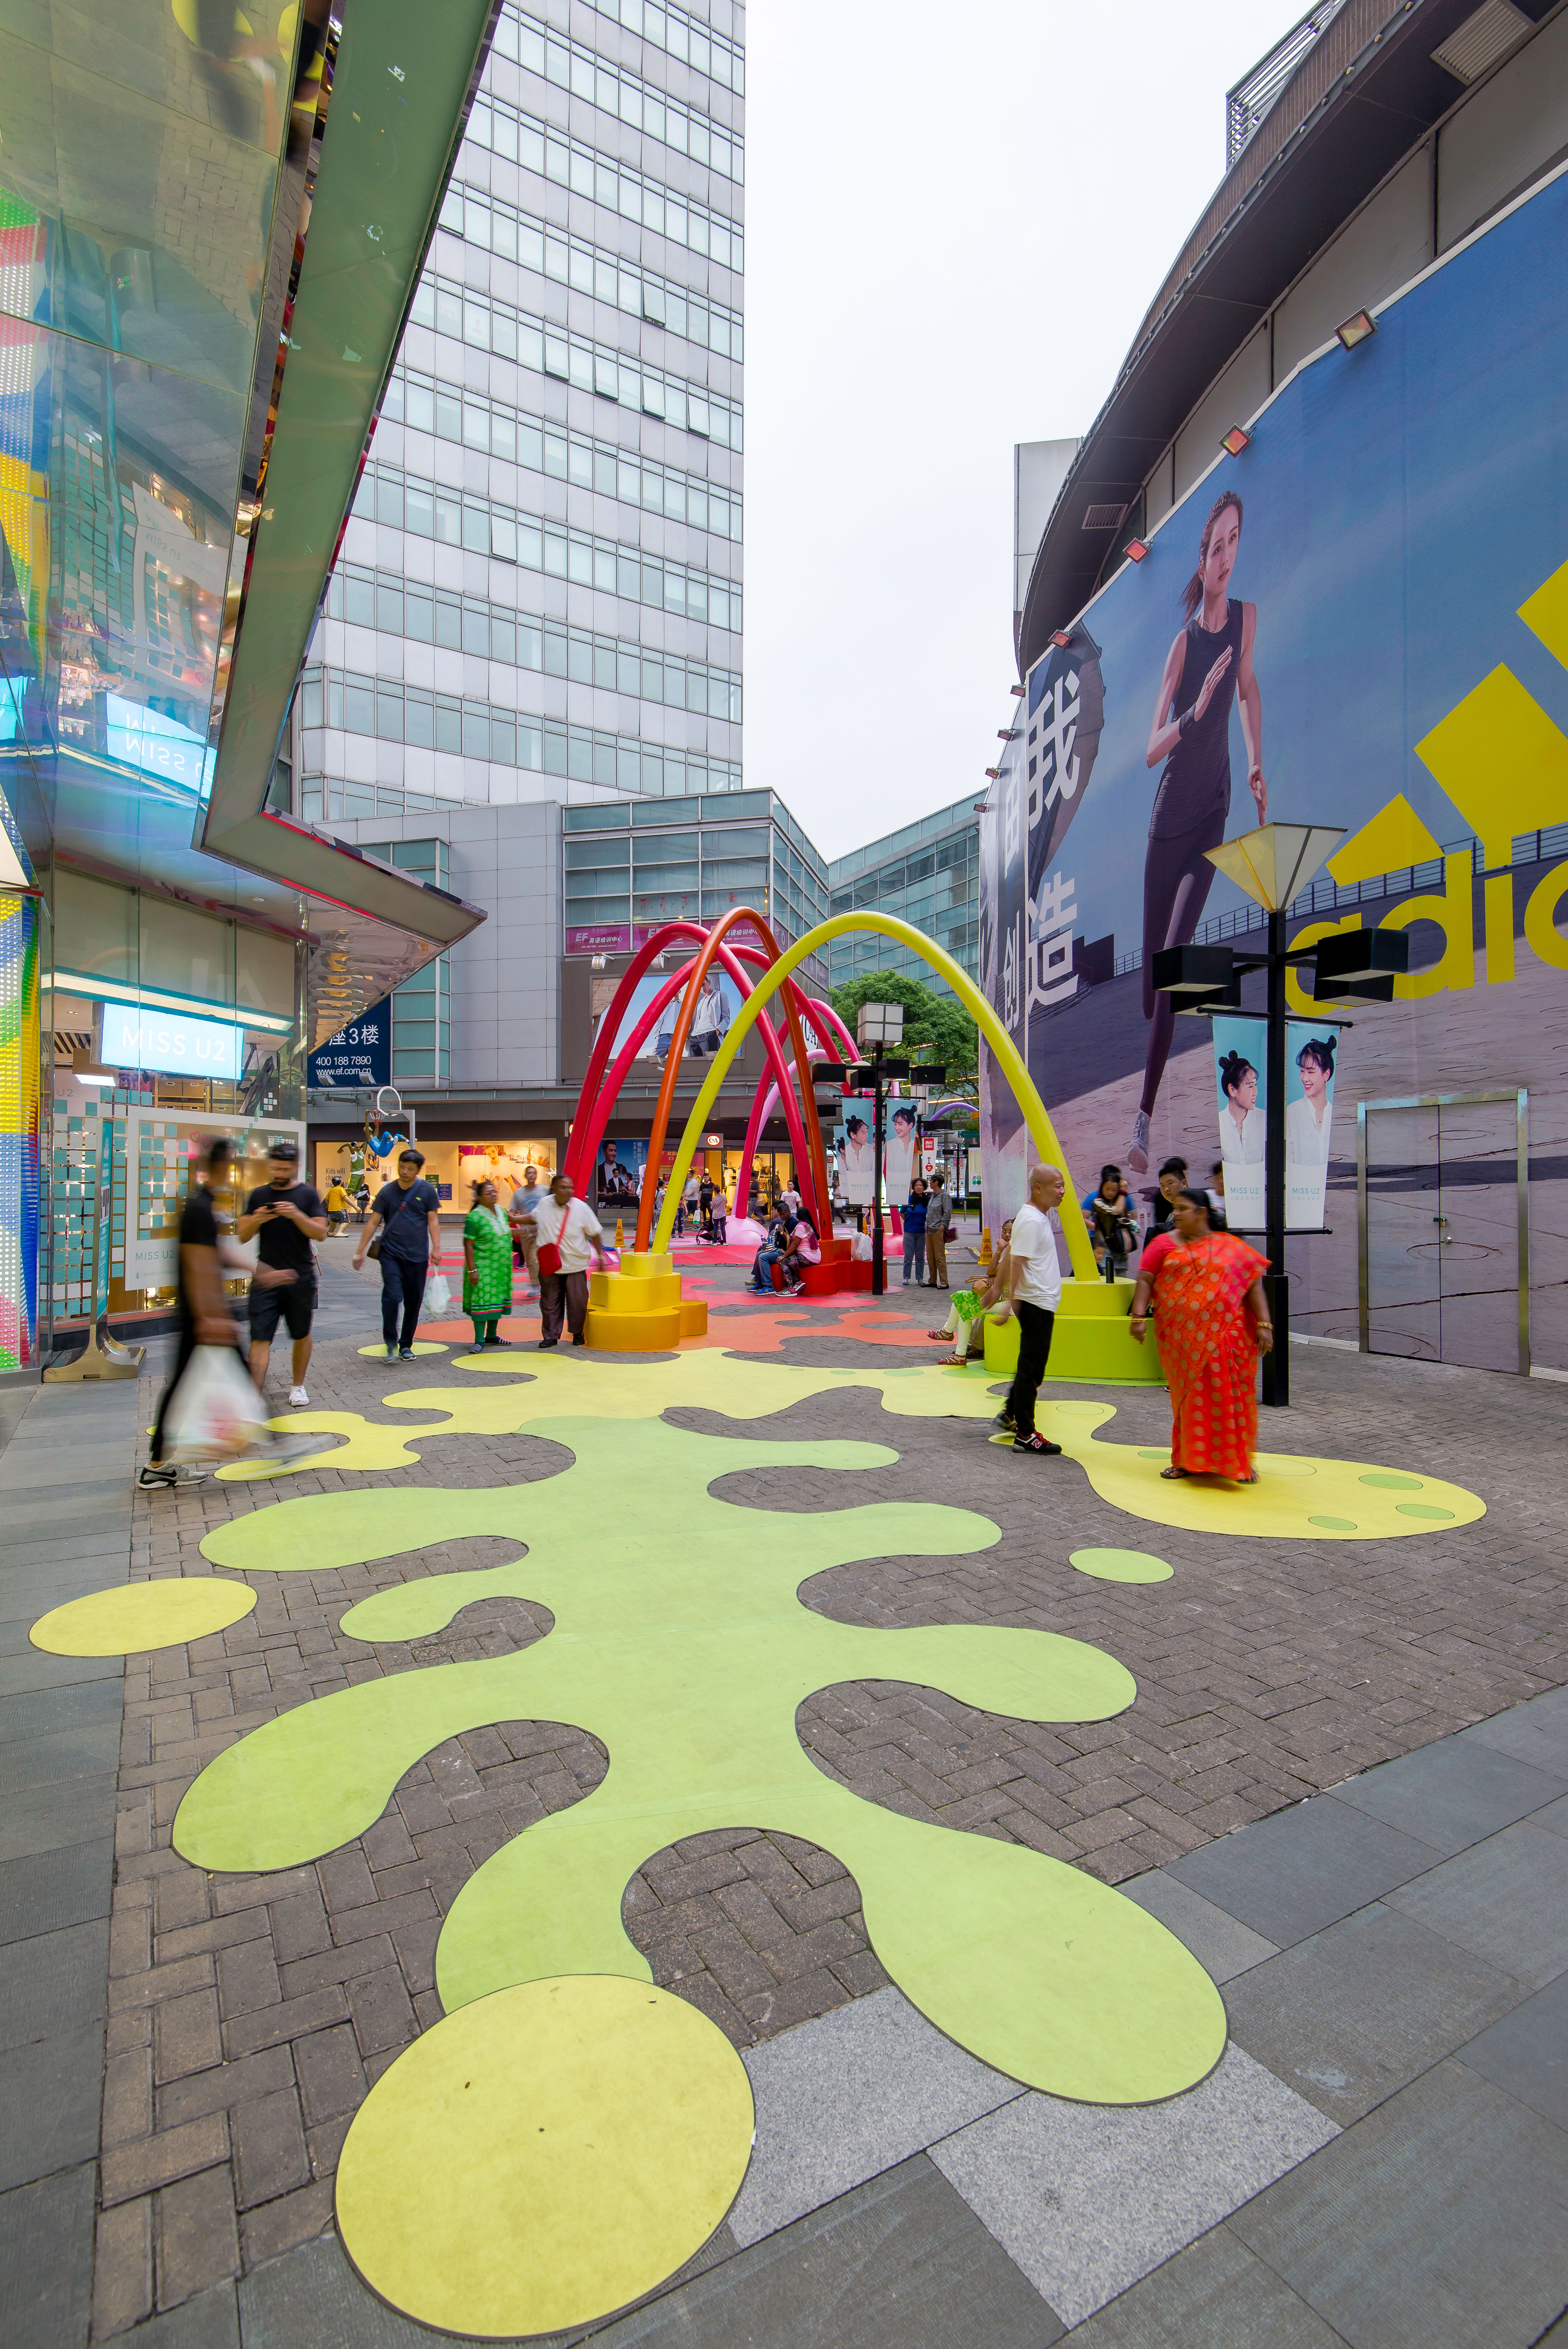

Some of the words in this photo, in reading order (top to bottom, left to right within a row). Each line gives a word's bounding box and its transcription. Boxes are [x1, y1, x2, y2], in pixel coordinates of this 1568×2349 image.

[576, 932, 588, 942] EF
[122, 1025, 186, 1055] MISS
[196, 1037, 225, 1062] U2
[316, 1057, 331, 1066] 400
[333, 1057, 349, 1065] 188
[351, 1056, 371, 1065] 7890
[57, 1089, 73, 1097] U2
[135, 1251, 159, 1261] MISS
[162, 1250, 175, 1258] U2
